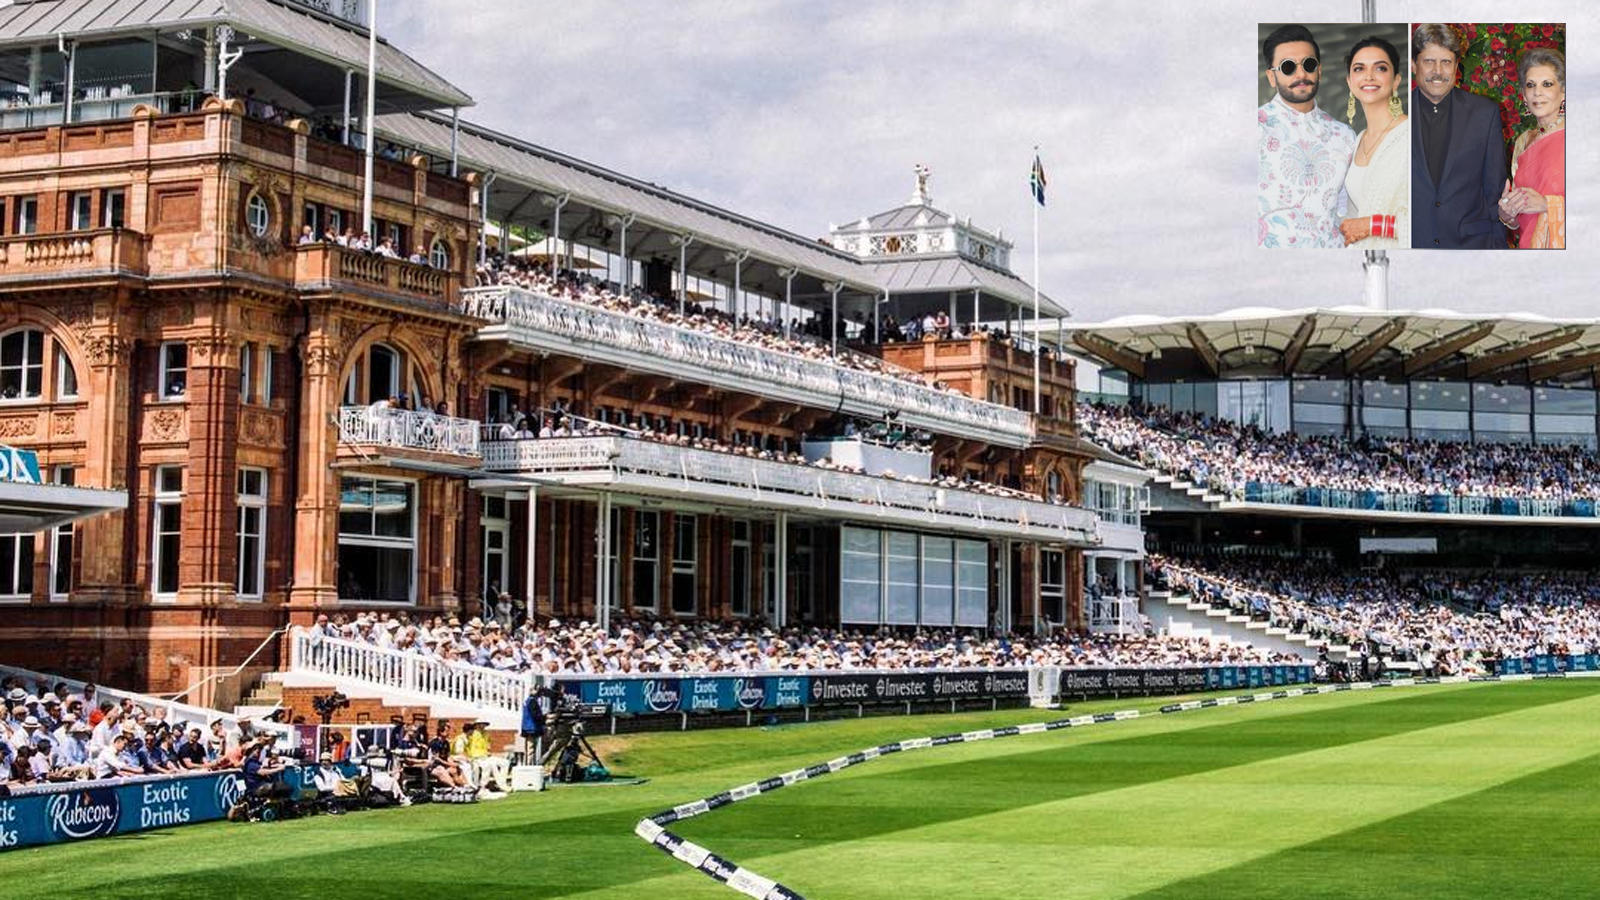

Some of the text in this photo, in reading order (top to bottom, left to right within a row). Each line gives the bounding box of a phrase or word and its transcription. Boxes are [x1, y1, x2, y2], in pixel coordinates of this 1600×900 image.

[599, 682, 626, 697] Exotic
[694, 680, 718, 693] Exotic
[778, 678, 800, 690] Exotic
[823, 679, 868, 698] Investec
[885, 679, 926, 696] Investec
[942, 676, 979, 693] Investec
[993, 674, 1026, 691] Investec
[643, 680, 679, 712] Rubicon
[692, 695, 719, 708] Drinks
[776, 692, 800, 705] Drinks
[143, 782, 188, 804] Exotic
[50, 794, 113, 837] Rubicon
[141, 805, 190, 828] Drinks
